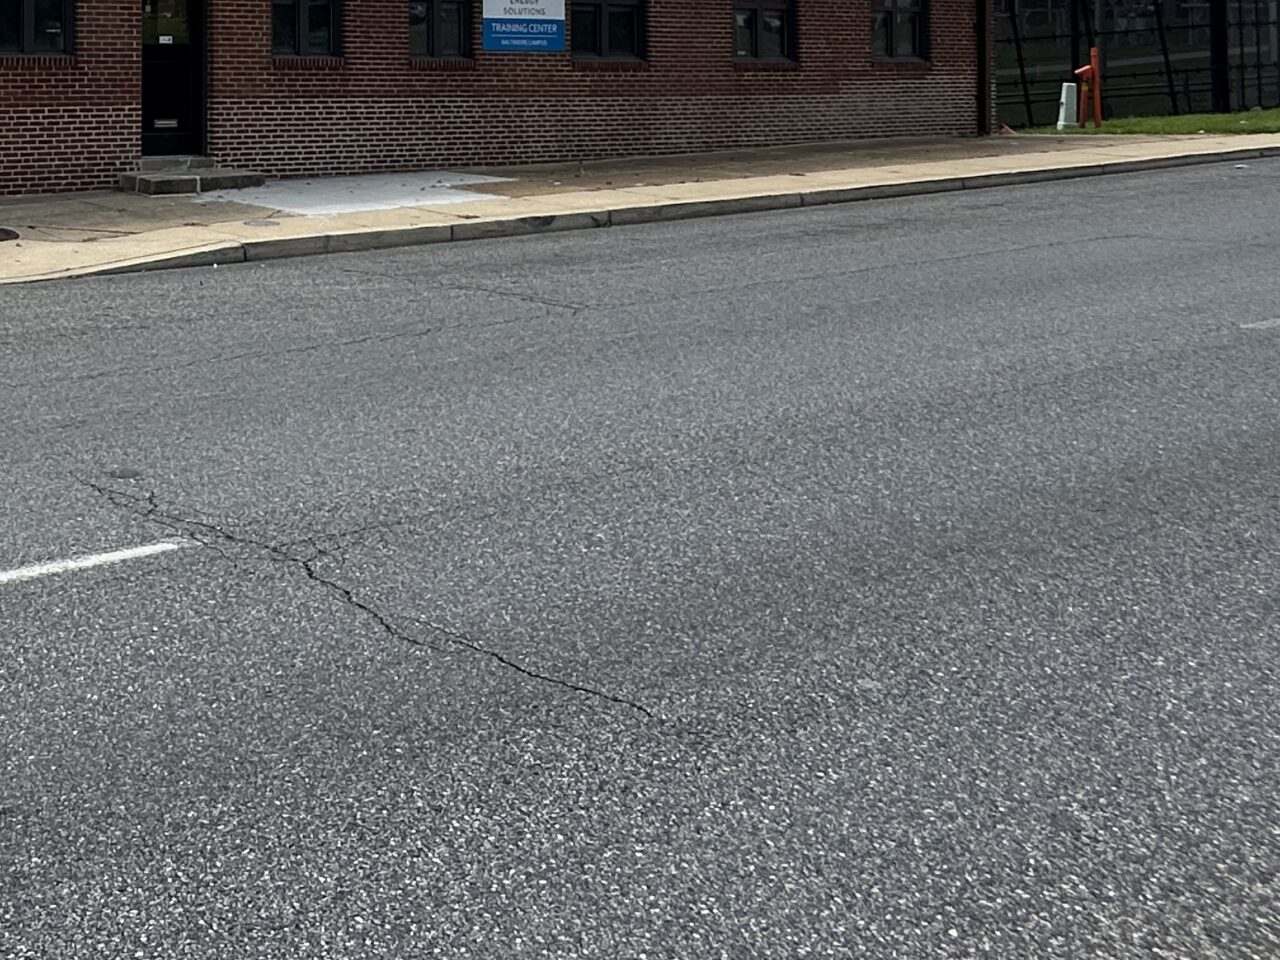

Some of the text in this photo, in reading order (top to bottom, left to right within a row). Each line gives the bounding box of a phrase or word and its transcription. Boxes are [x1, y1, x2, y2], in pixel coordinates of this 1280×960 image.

[504, 7, 546, 16] SOLUTIONS
[492, 23, 557, 33] TRAINING CENTER
